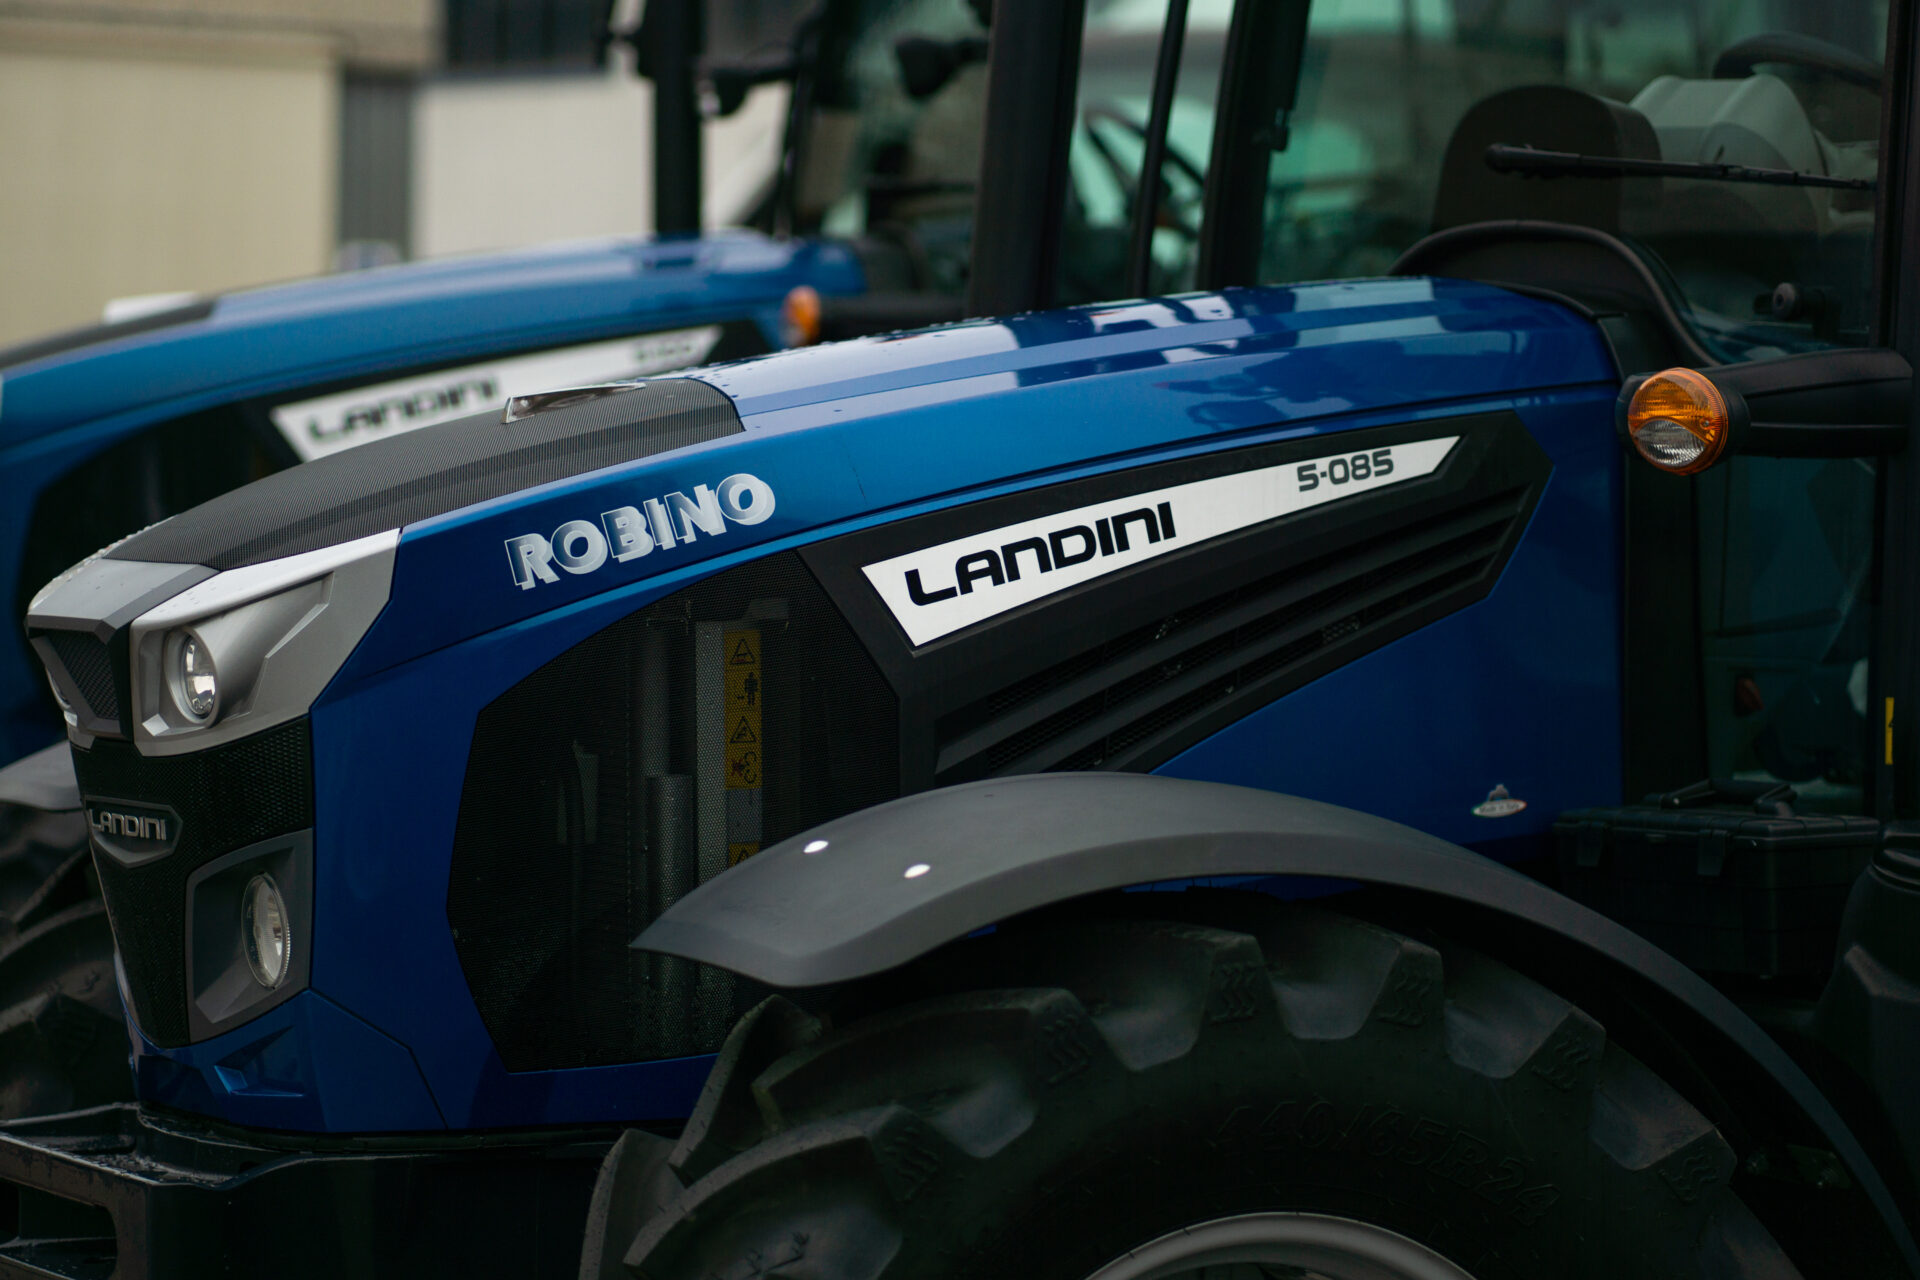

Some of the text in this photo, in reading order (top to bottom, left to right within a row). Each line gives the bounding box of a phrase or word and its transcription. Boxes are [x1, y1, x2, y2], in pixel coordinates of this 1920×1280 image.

[305, 379, 502, 441] LANDINI
[504, 473, 776, 591] ROBINO
[904, 448, 1394, 606] LANDINI 5-085
[88, 808, 167, 841] LANDINI
